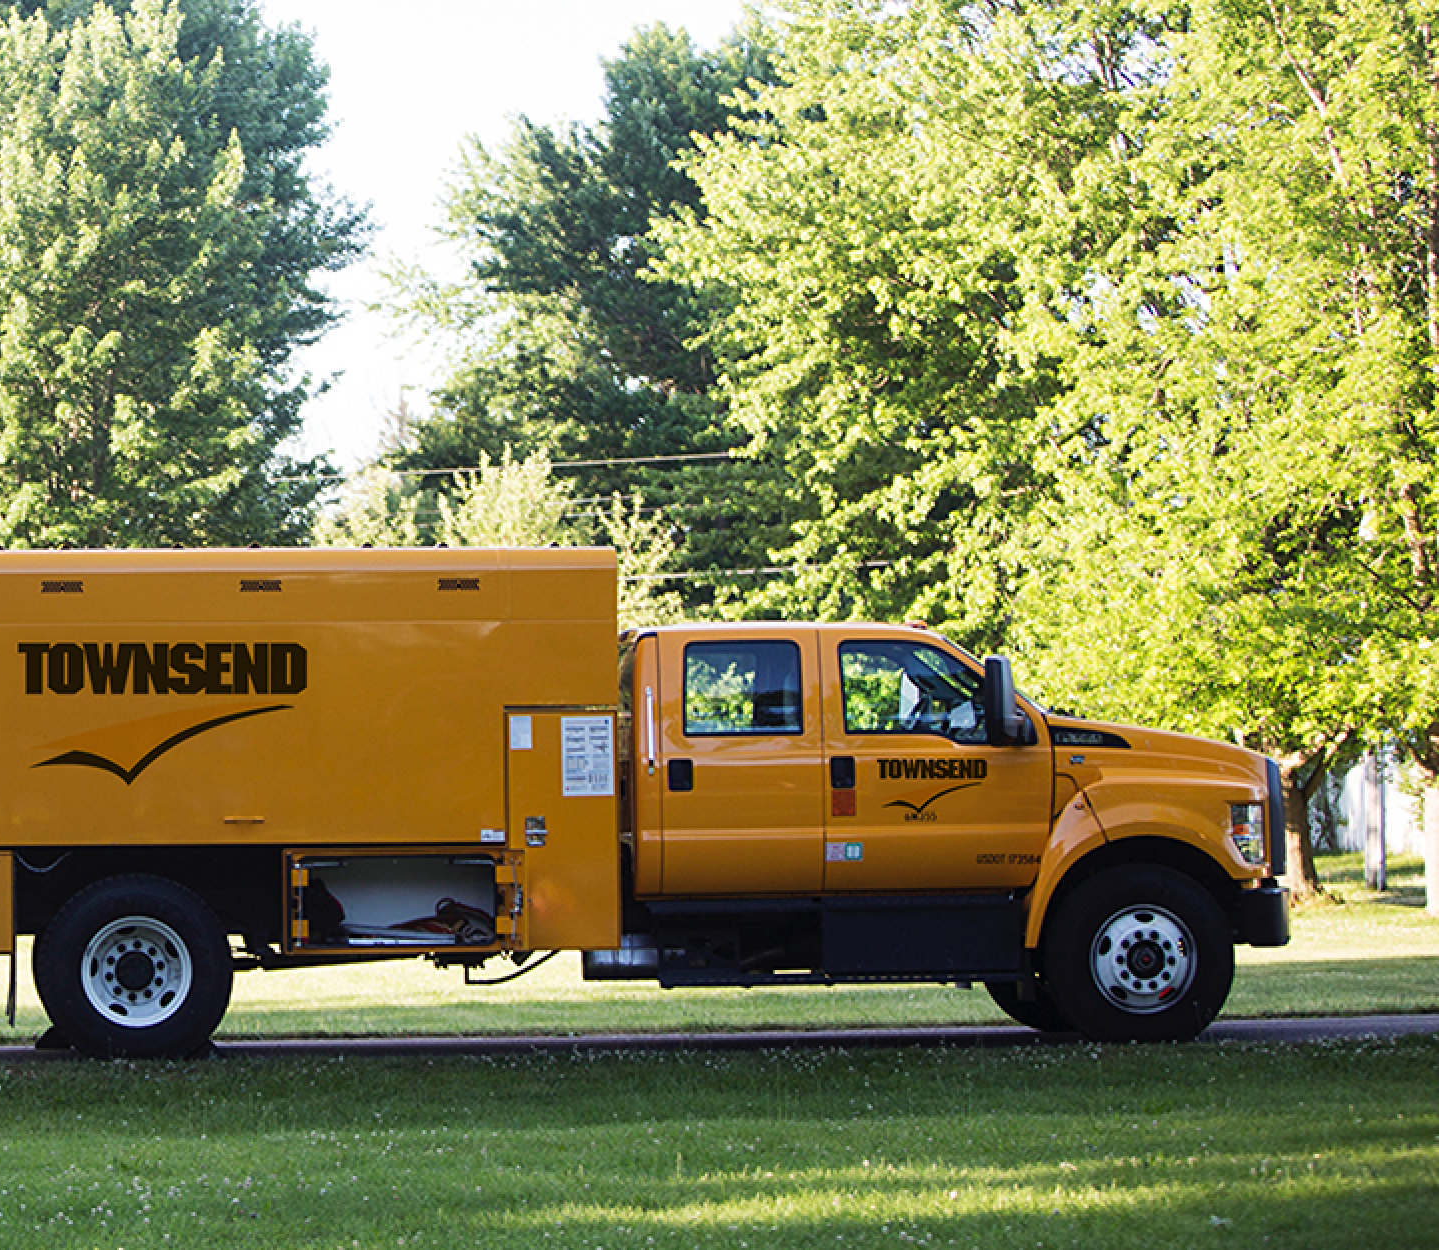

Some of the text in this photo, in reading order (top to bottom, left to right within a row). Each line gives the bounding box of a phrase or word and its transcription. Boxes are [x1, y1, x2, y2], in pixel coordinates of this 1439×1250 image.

[18, 642, 308, 695] TOWNSEND
[877, 758, 988, 779] TOWNSEND
[976, 854, 1006, 865] USDOT
